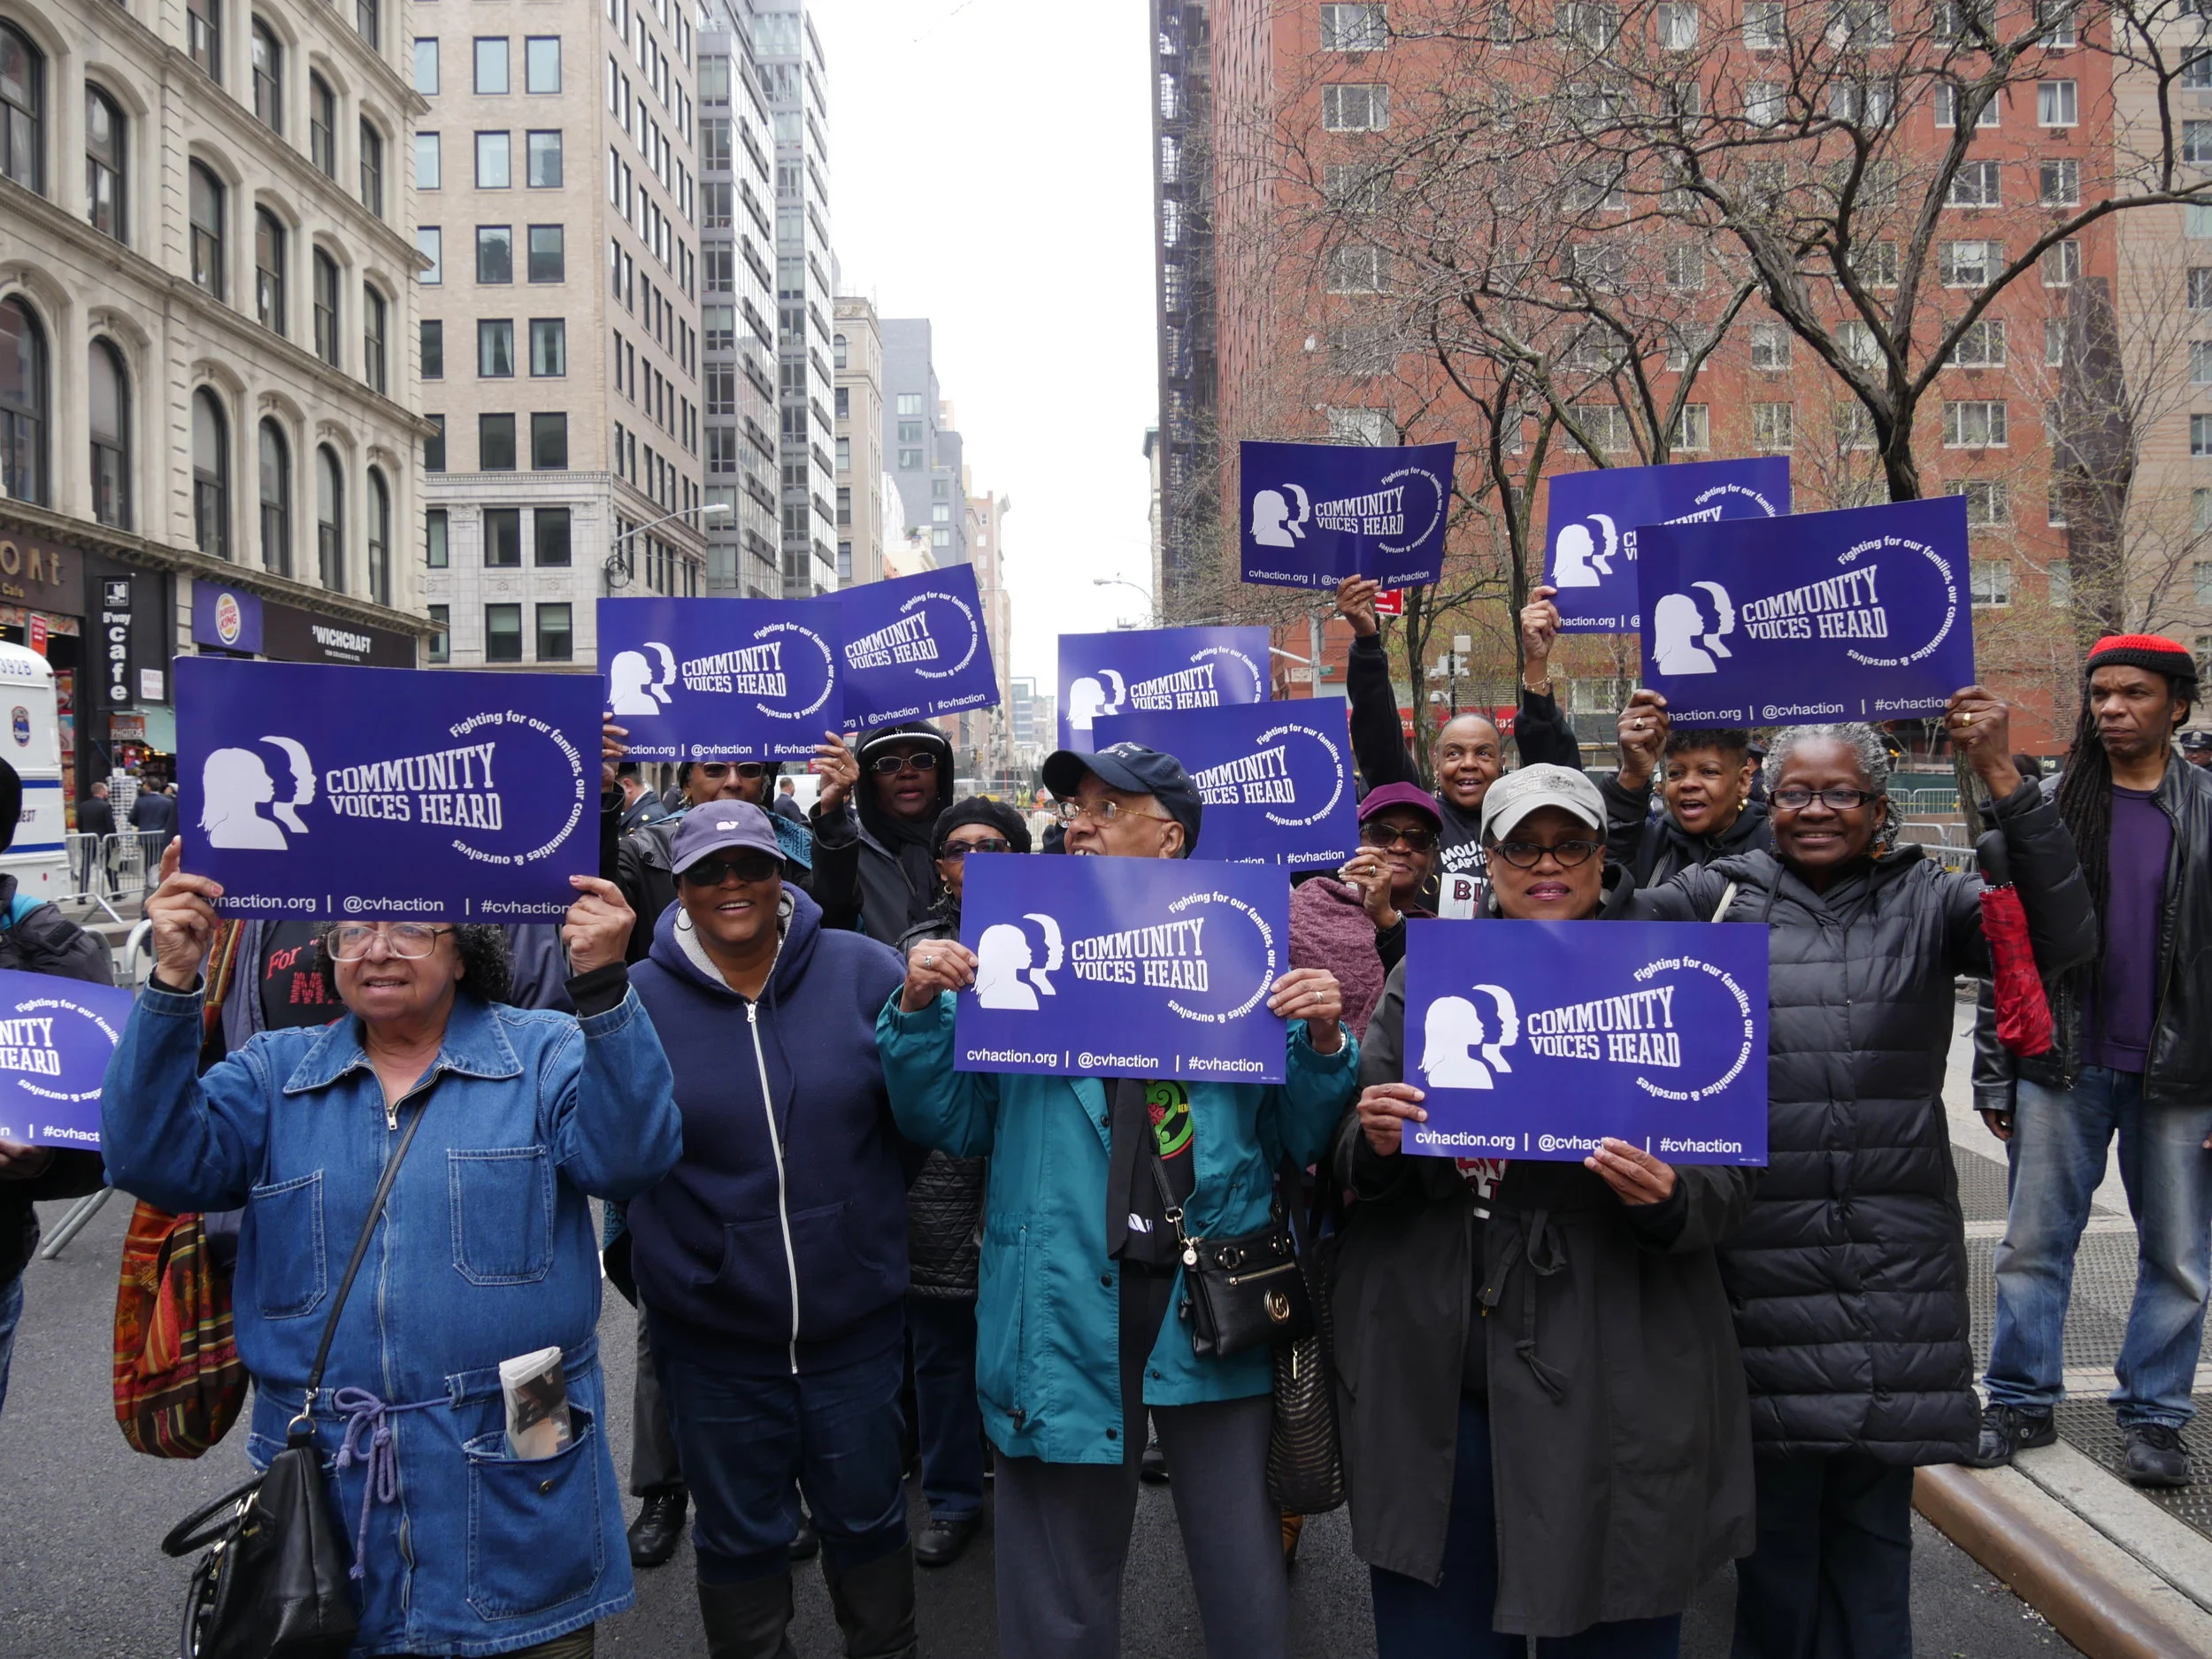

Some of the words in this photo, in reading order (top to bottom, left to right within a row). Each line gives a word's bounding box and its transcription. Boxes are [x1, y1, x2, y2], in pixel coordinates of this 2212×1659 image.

[1316, 486, 1404, 516] COMMUNITY
[1694, 486, 1726, 505] Fighting
[1727, 483, 1740, 492] for
[1741, 488, 1755, 497] our
[1316, 518, 1358, 534] VOICES
[1363, 513, 1403, 534] HEARD
[1884, 535, 1901, 546] for
[1903, 540, 1923, 550] our
[1838, 539, 1882, 565] Fighting
[1249, 570, 1308, 583] cvhaction.org
[1388, 571, 1429, 583] #cvhaction
[900, 595, 926, 613] Fighting
[1742, 565, 1878, 622] COMMUNITY
[1947, 586, 1957, 603] our
[754, 624, 785, 640] Fighting
[786, 622, 798, 631] for
[799, 627, 812, 636] our
[1558, 616, 1616, 628] haction.org
[1745, 618, 1811, 639] VOICES
[1817, 607, 1888, 638] HEARD
[845, 611, 929, 658] COMMUNITY
[1910, 606, 1956, 661] communities
[682, 641, 781, 676] COMMUNITY
[848, 650, 891, 669] VOICES
[893, 638, 938, 664] HEARD
[954, 634, 978, 672] communities
[1190, 648, 1217, 663] Fighting
[1847, 649, 1897, 666] ourselves
[683, 676, 732, 693] VOICES
[737, 672, 787, 696] HEARD
[915, 668, 947, 679] ourselves
[1131, 664, 1214, 697] COMMUNITY
[801, 680, 833, 716] communities
[868, 707, 919, 724] @cvhaction
[937, 693, 986, 710] #cvhaction
[1132, 695, 1172, 710] VOICES
[1176, 690, 1218, 709] HEARD
[506, 710, 526, 724] for
[757, 703, 792, 718] ourselves
[1667, 709, 1742, 722] haction.org
[1763, 703, 1843, 719] @cvhaction
[449, 712, 503, 737] Fighting
[528, 718, 551, 733] our
[1289, 723, 1302, 732] for
[1303, 727, 1317, 736] our
[1256, 726, 1288, 745] Fighting
[690, 743, 753, 757] @cvhaction
[773, 743, 817, 755] #cvhact
[326, 742, 495, 793] COMMUNITY
[576, 779, 585, 800] our
[1199, 786, 1240, 805] OICES
[1243, 778, 1295, 803] HEARD
[327, 795, 411, 821] VOICES
[419, 793, 502, 830] HEARD
[1312, 780, 1343, 823] communities
[1265, 812, 1303, 826] ourselves
[526, 803, 582, 861] communities
[452, 840, 511, 864] ourselves
[1287, 849, 1345, 864] #cvhaction
[343, 896, 443, 913] @cvhaction
[1169, 893, 1210, 913] Fighting
[1213, 891, 1229, 902] for
[1231, 898, 1248, 910] our
[1072, 918, 1203, 960] COMMUNITY
[266, 947, 302, 980] For
[1633, 958, 1680, 981] Fighting
[1682, 956, 1701, 968] for
[1702, 964, 1723, 977] our
[1072, 962, 1135, 984] VOICES
[1143, 960, 1208, 992] HEARD
[15, 998, 58, 1012] Fighting
[60, 999, 77, 1010] for
[1228, 969, 1274, 1020] communities
[77, 1007, 96, 1018] our
[1168, 1000, 1214, 1022] ourselves
[1528, 986, 1674, 1034] COMMUNITY
[1744, 1019, 1753, 1039] our
[967, 1048, 1056, 1067] cvhaction.org
[1079, 1052, 1158, 1068] @cvhaction
[1189, 1056, 1263, 1072] #cvhaction
[1529, 1035, 1600, 1060] VOICES
[1608, 1033, 1680, 1067] HEARD
[1701, 1041, 1752, 1096] communities
[18, 1079, 69, 1100] ourselves
[1636, 1077, 1688, 1101] ourselves
[42, 1125, 100, 1143] #cvhact
[1416, 1132, 1516, 1152] cvhaction.org
[1660, 1138, 1741, 1153] #cvhaction
